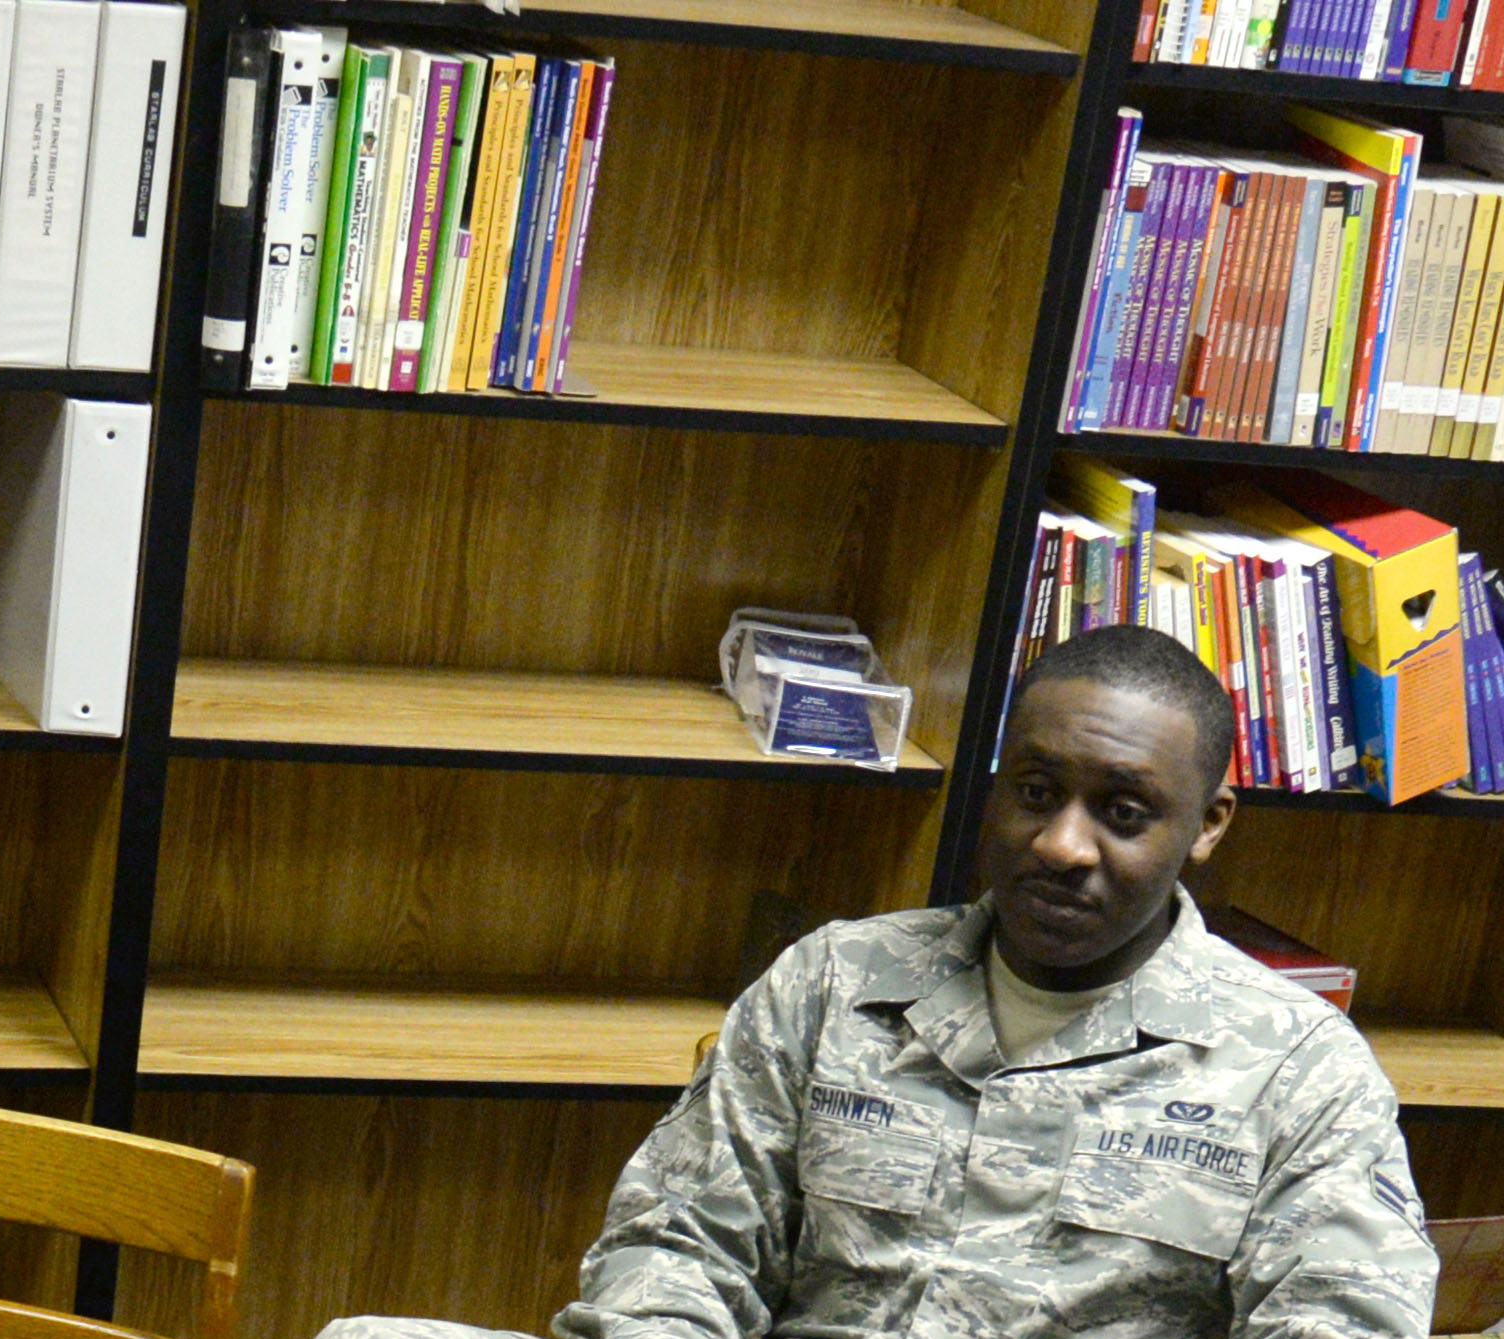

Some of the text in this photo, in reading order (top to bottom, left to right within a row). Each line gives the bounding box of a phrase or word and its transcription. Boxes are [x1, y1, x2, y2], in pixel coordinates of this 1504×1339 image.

[486, 100, 504, 150] Principles
[506, 99, 525, 150] Principles
[28, 103, 44, 199] OWNER'S MANUAL
[42, 68, 65, 237] STARLAB PLANETARIUM SYSTEM
[138, 92, 159, 222] STARLAB CURRICULUM
[279, 108, 300, 213] Problem Solver
[305, 101, 327, 204] Problem Solver
[483, 154, 495, 172] and
[504, 154, 516, 171] and
[343, 160, 369, 278] MATHEMATICS Grades
[406, 85, 451, 319] HANDS-ON MATH PROJECTS REAL-LIFE APPLICAT
[475, 176, 492, 225] Standards
[496, 174, 513, 223] Standards
[467, 244, 482, 279] School
[488, 243, 503, 277] School
[457, 282, 476, 343] Mathematics
[478, 280, 497, 342] Mathematics
[1309, 220, 1339, 356] Strategies Work
[1136, 530, 1153, 595] REVISER'S
[1316, 562, 1329, 583] The
[1318, 586, 1330, 602] Art
[1319, 618, 1337, 664] Teaching
[1324, 667, 1340, 704] Writing
[1097, 1130, 1249, 1177] U.S. AIR FORCE
